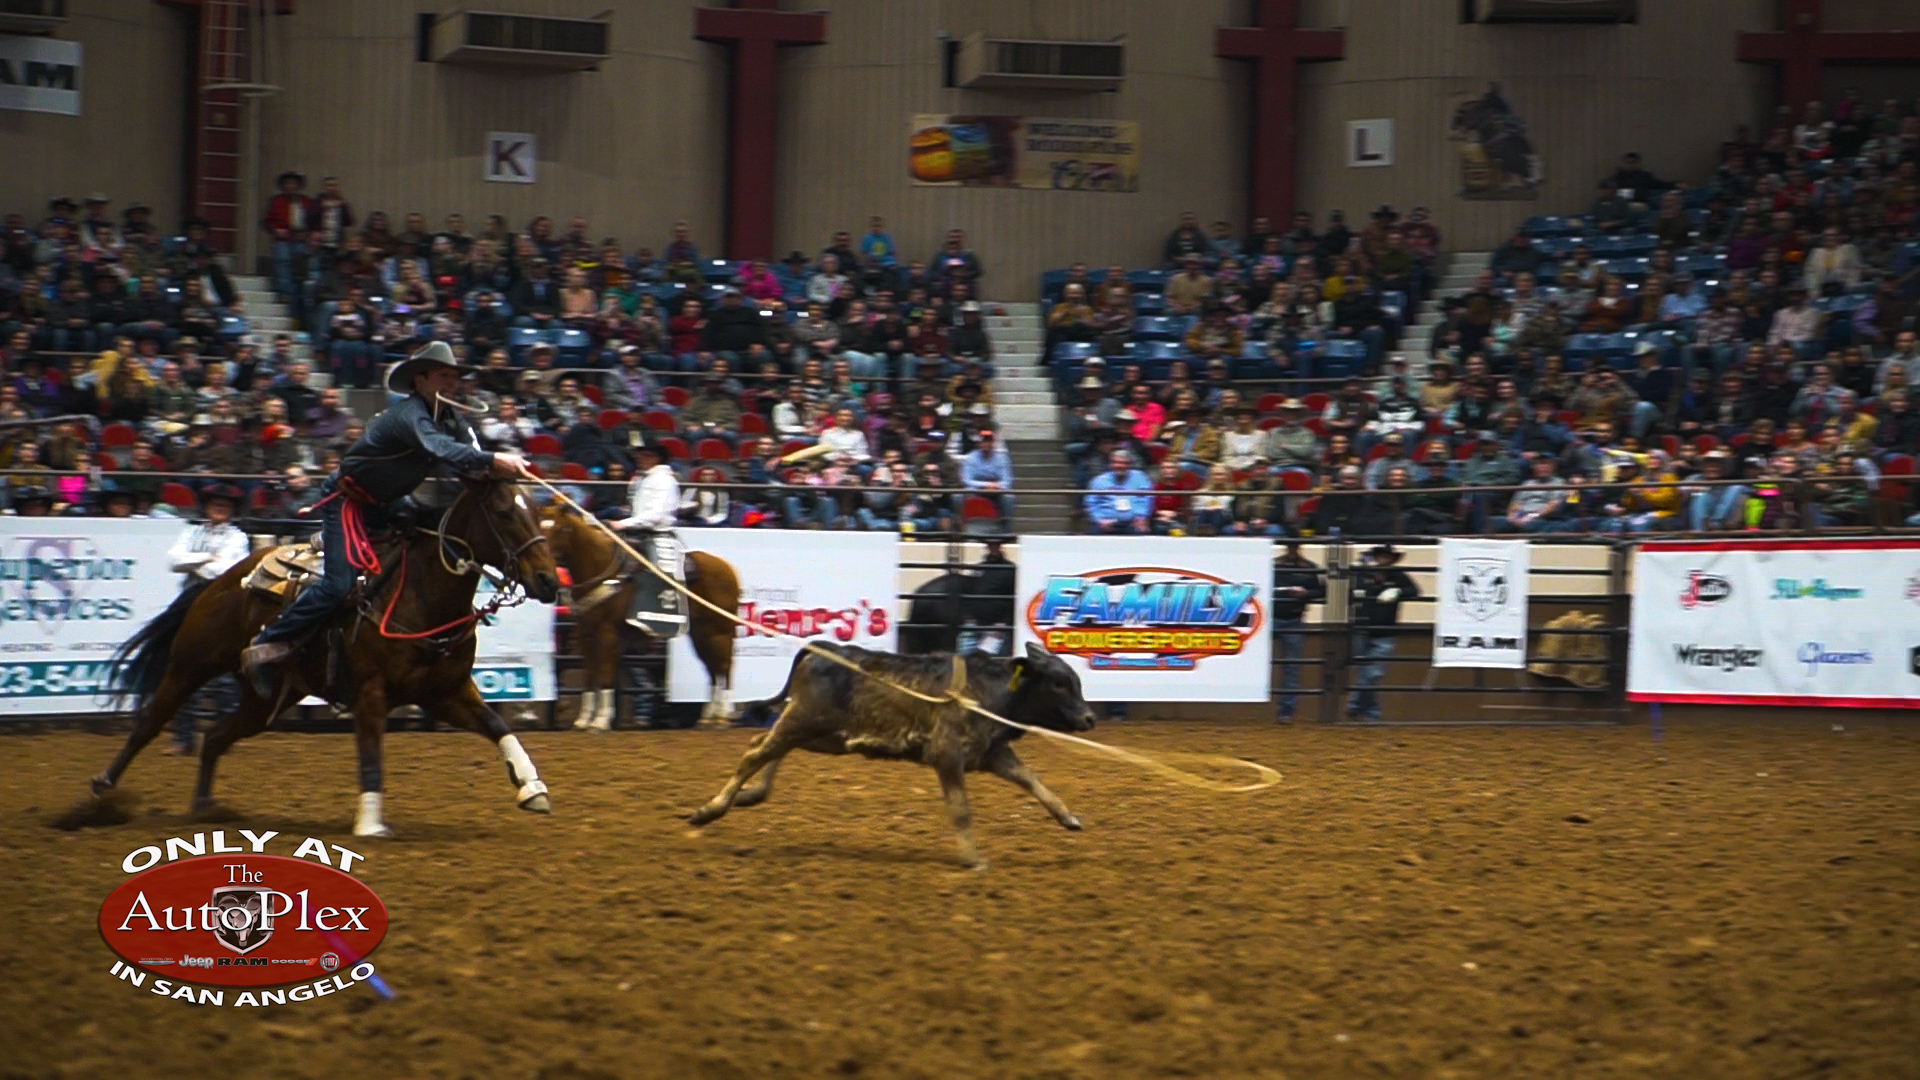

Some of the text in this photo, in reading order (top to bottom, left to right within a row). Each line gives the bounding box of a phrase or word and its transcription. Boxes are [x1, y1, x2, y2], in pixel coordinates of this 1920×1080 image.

[491, 139, 529, 177] K
[1354, 128, 1384, 161] L
[1036, 576, 1257, 627] FAMILY
[1047, 630, 1241, 649] POWERSPORTS
[1437, 635, 1521, 649] RAM
[1673, 643, 1763, 672] Wrangler
